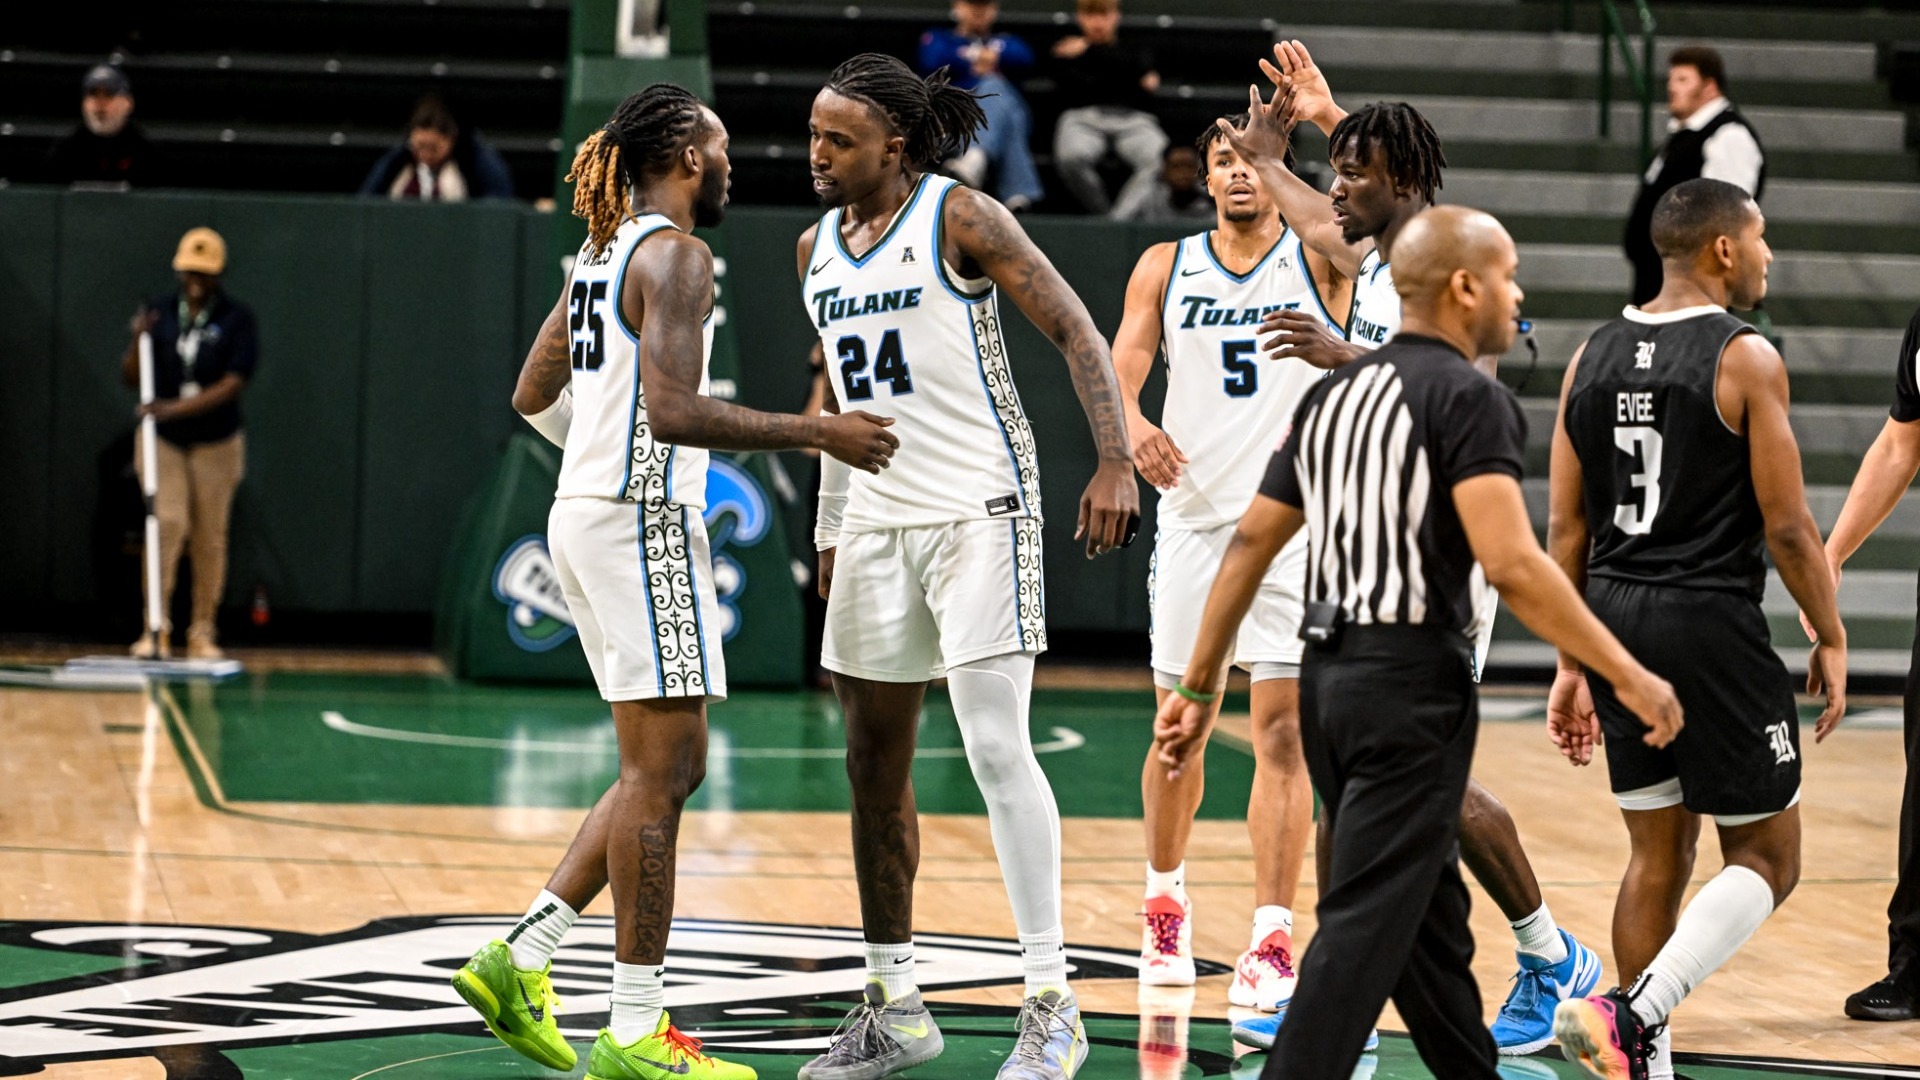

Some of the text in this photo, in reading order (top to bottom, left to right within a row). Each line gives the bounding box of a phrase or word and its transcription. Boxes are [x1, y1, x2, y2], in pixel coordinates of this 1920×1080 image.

[569, 279, 609, 373] 25
[812, 285, 924, 329] TULANE
[1180, 295, 1301, 329] TULAN
[836, 328, 914, 403] 24
[1221, 339, 1258, 399] 5
[1617, 392, 1655, 422] EVEE
[1613, 426, 1663, 535] 3
